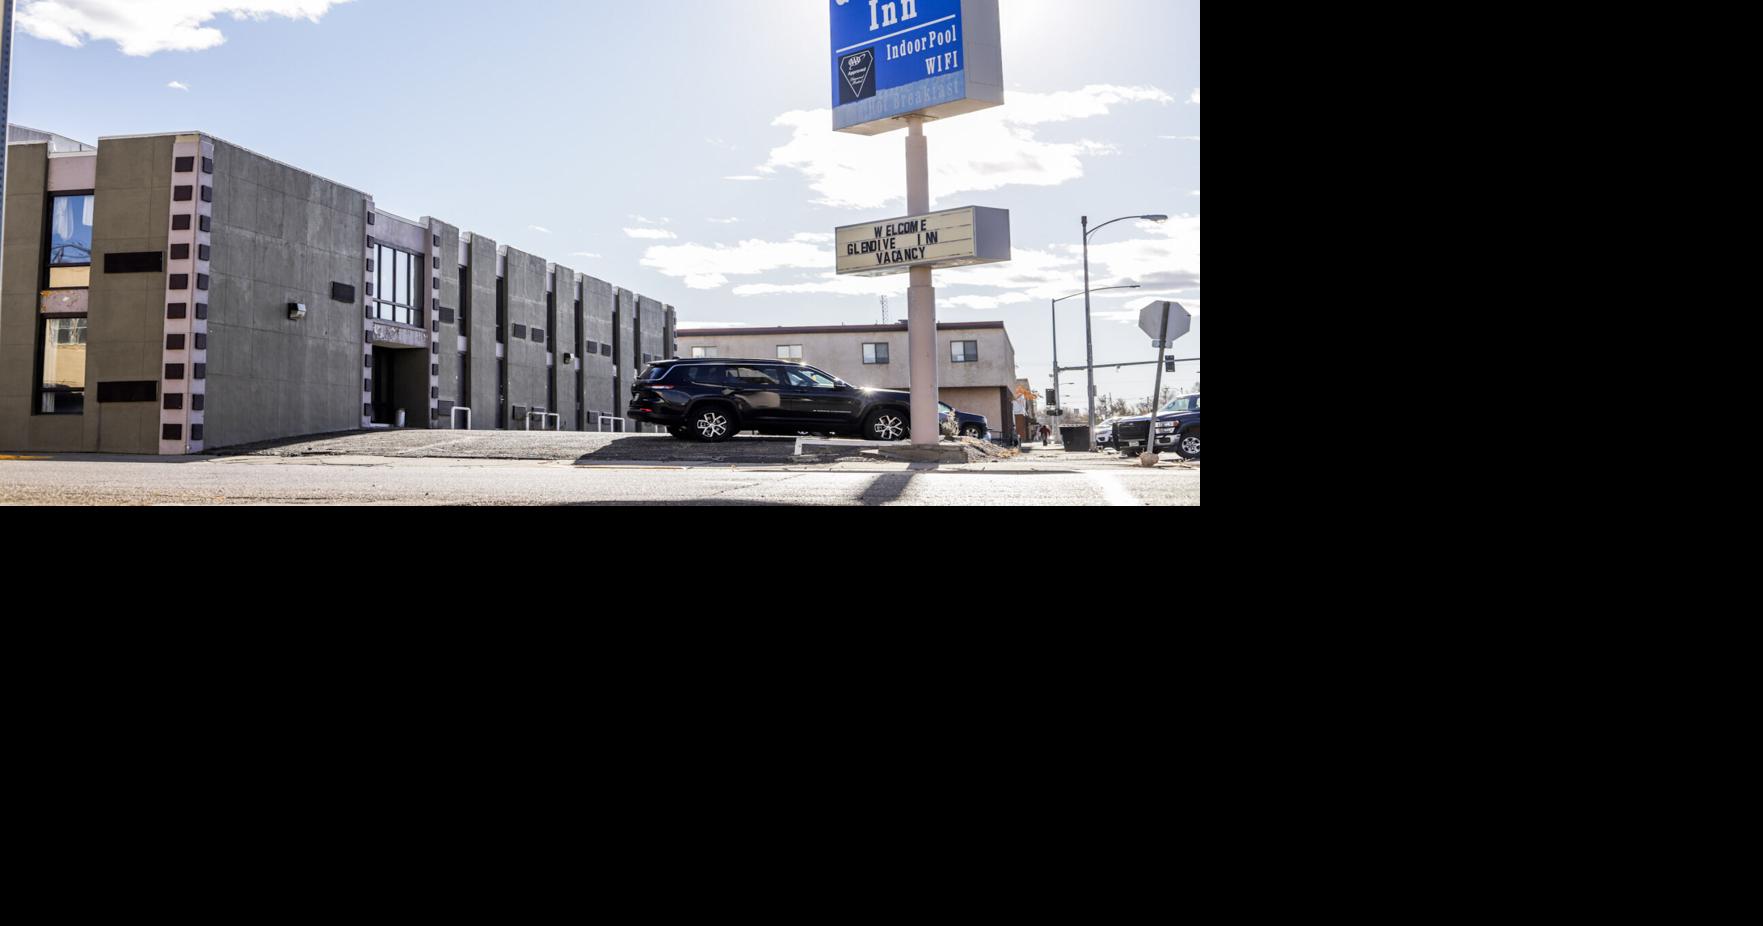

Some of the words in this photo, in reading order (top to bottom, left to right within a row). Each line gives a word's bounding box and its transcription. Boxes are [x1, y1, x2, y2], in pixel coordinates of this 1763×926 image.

[869, 0, 917, 31] Inn
[887, 36, 927, 61] Indoor
[929, 25, 957, 48] Pool
[925, 51, 958, 75] WIFI
[874, 219, 927, 238] WELCOME
[847, 237, 896, 255] GLENDIVE
[917, 231, 938, 246] INN
[876, 247, 925, 265] VACANCY
